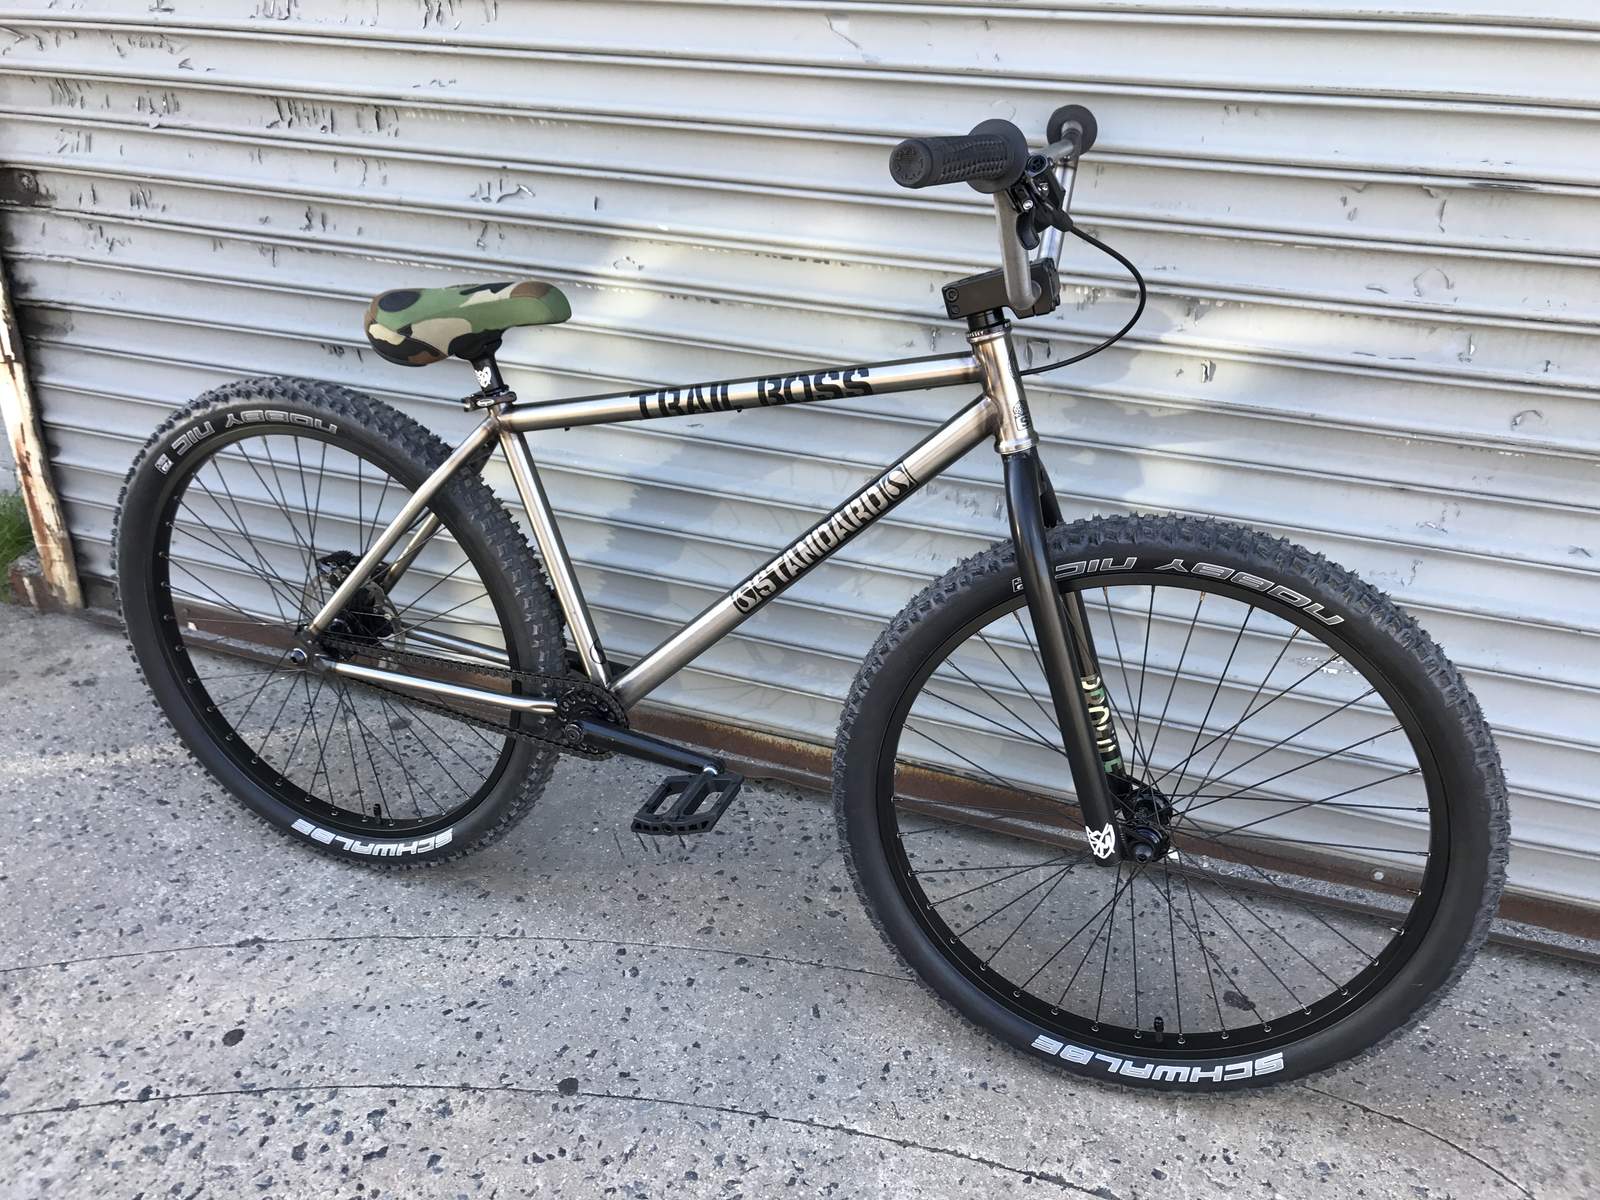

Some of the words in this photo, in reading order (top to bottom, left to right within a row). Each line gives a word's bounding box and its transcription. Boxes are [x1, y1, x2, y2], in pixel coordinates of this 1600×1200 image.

[629, 382, 738, 419] TRAIL
[757, 367, 874, 407] BOSS
[172, 421, 216, 456] NIC
[225, 409, 338, 434] NOBBY
[753, 481, 890, 601] STANDARD
[1055, 556, 1138, 580] NIC
[1153, 558, 1345, 626] NOBBY
[290, 818, 453, 857] SCHWALBE
[1030, 1034, 1285, 1083] SCHWALBE
